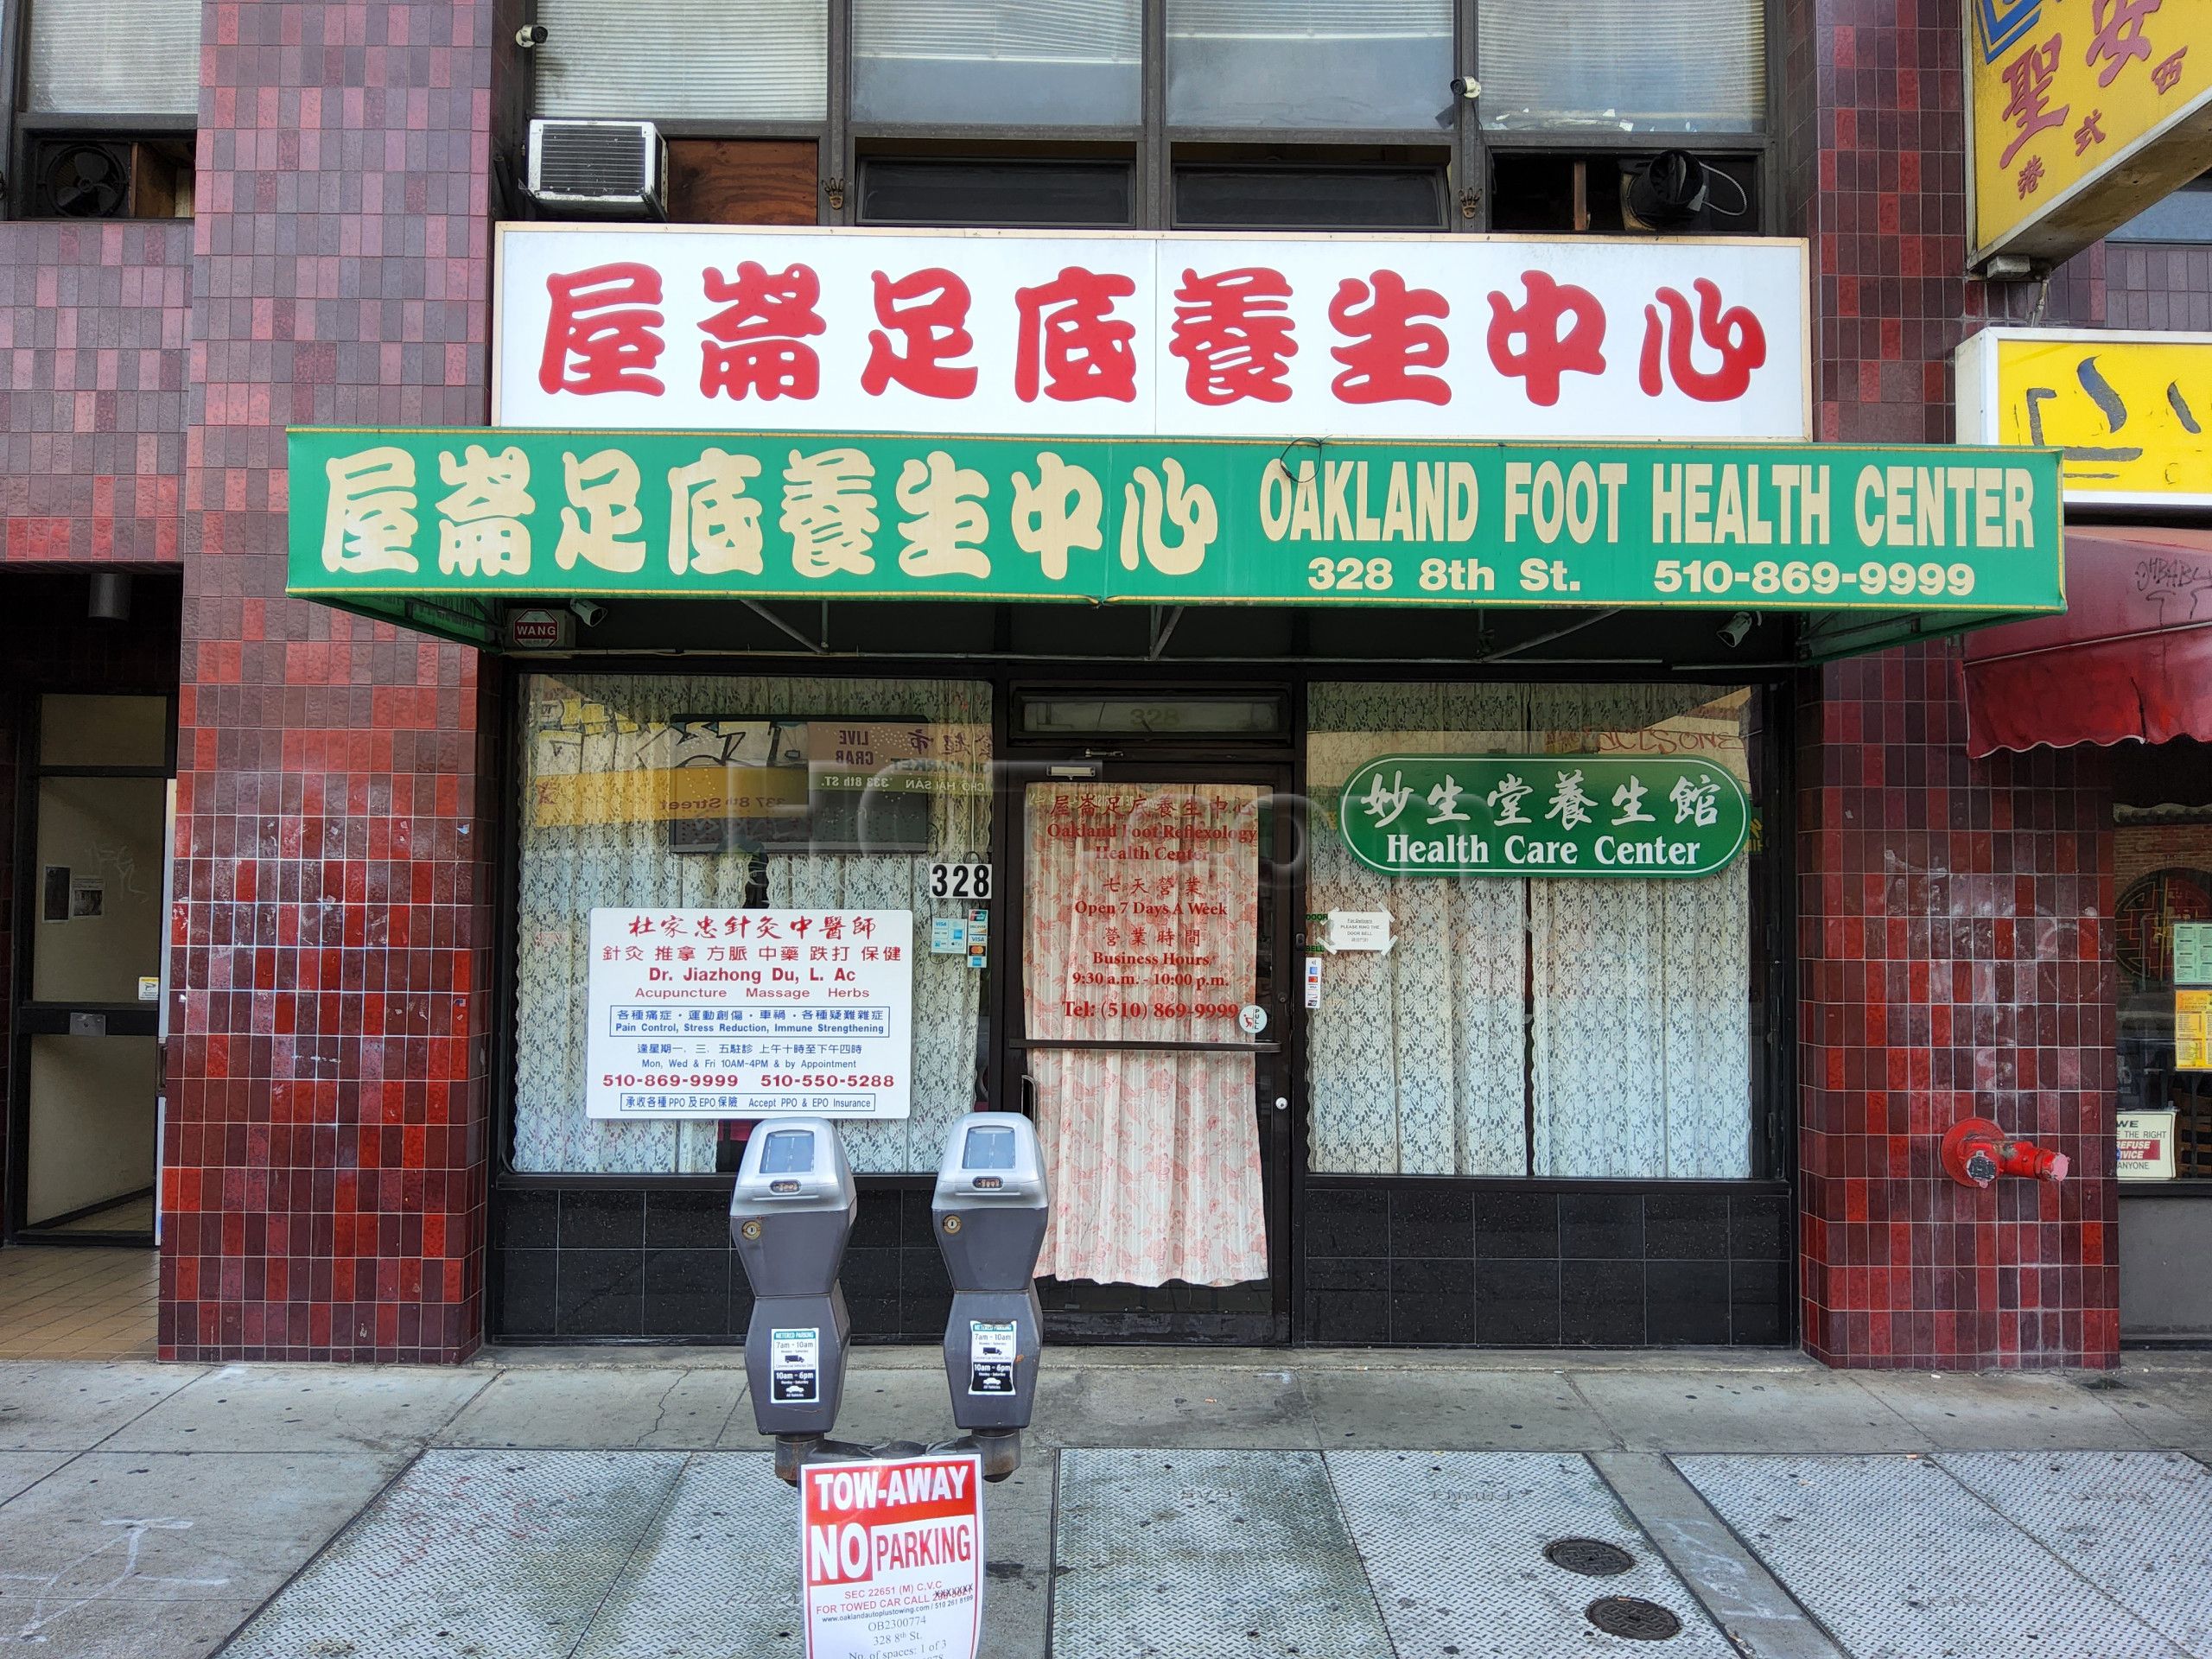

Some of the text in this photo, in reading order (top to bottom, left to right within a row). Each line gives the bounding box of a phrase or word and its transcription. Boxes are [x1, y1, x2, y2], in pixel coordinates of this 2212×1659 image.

[538, 259, 1766, 407] 屋崙足底養生中心
[321, 444, 1218, 580] 屋崙足底養生中心
[1259, 460, 2034, 548] OAKLAND FOOT HEALTH CENTER
[1307, 557, 1974, 596] 328 8th St. 510-869-9999
[517, 626, 556, 635] WANG
[1130, 709, 1179, 726] 328
[1360, 769, 1721, 830] 妙生堂養生館
[1047, 823, 1258, 842] Oakland Foot Reflexology
[1096, 846, 1209, 861] Health Center
[1386, 833, 1700, 865] Health Care Center
[931, 864, 989, 897] 328
[1074, 901, 1227, 917] Open 7 Days A Week
[628, 915, 876, 940] 杜家忠針灸中醫師
[602, 945, 644, 961] 針灸
[654, 945, 696, 961] 推拿
[759, 946, 799, 962] 中藥
[810, 946, 850, 962] 跌打
[861, 946, 901, 962] 保健
[1092, 951, 1159, 965] Business
[649, 967, 856, 984] Dr. Jiazhong Du, L. Ac
[1071, 972, 1103, 986] 9:30
[1106, 975, 1140, 986] a.m.
[1154, 972, 1192, 986] 10:00
[1196, 975, 1229, 989] p.m.
[635, 988, 870, 1000] Acupuncture Massage Herbs
[1061, 1001, 1239, 1021] Tel: (510) 869-9999
[615, 1023, 636, 1032] Pain
[641, 1023, 679, 1033] Control,
[683, 1023, 714, 1032] Stress
[719, 1023, 770, 1033] Reduction,
[817, 1024, 884, 1034] Strengthening
[642, 1059, 663, 1069] Mon,
[669, 1059, 688, 1068] Wed
[693, 1059, 700, 1068] &
[705, 1059, 715, 1068] Fri
[785, 1059, 796, 1069] by
[801, 1059, 856, 1070] Appointment
[602, 1074, 894, 1087] 510-869-9999 510-550-5288
[748, 1098, 776, 1109] Accept
[781, 1098, 798, 1107] PPO
[802, 1098, 808, 1107] &
[812, 1098, 829, 1107] EPO
[833, 1098, 871, 1108] Insurance
[996, 1363, 1011, 1372] 6pm
[815, 1465, 969, 1511] TOW-AWAY
[810, 1522, 970, 1580] NO PARKING
[844, 1580, 942, 1599] SEC 22651 (M) C.V.C
[816, 1595, 928, 1614] FOR TOWED CAR CALL
[822, 1605, 930, 1623] www.oaklandautoplustowing.com
[868, 1616, 926, 1632] OB2300774
[874, 1635, 891, 1646] 328
[869, 1649, 881, 1659] of
[929, 1641, 940, 1651] of
